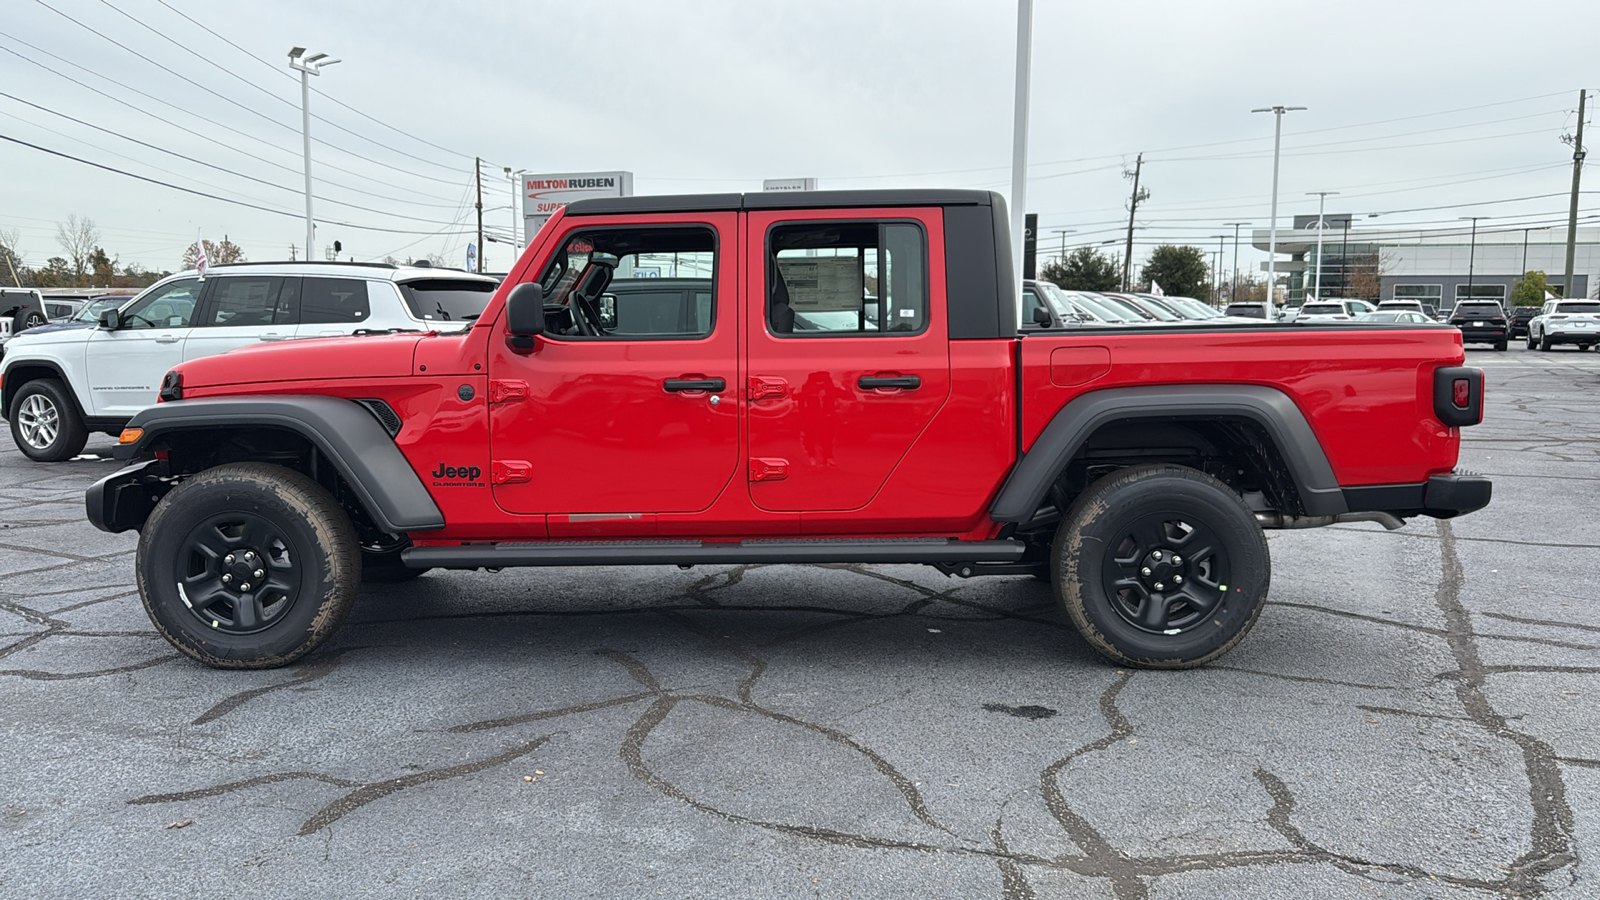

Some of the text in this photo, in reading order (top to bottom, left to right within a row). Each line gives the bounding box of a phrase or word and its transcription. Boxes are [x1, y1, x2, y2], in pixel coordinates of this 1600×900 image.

[527, 178, 614, 190] MILTON RUBEN
[432, 461, 481, 481] Jeep
